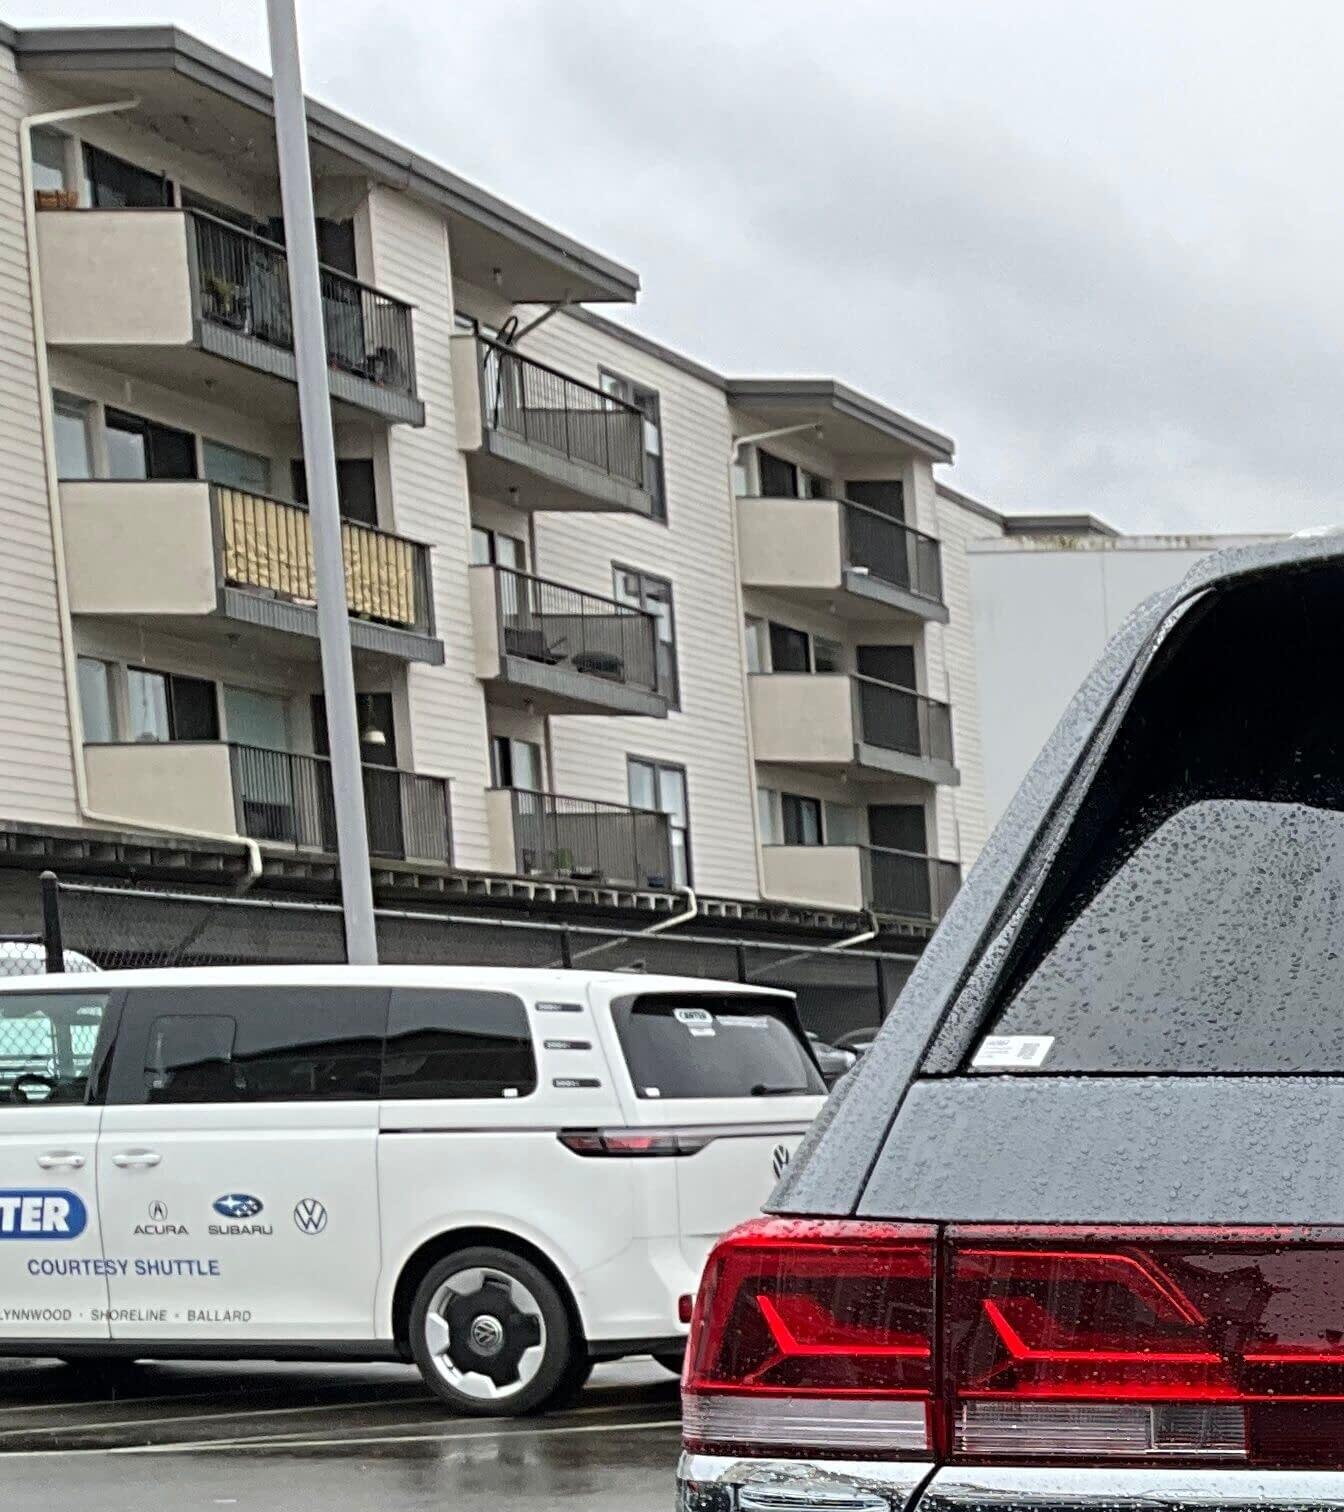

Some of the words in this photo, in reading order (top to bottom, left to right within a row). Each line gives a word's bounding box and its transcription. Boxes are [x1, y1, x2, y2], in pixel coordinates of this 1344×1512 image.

[133, 1223, 189, 1236] ACURA
[207, 1224, 274, 1236] SUBARU
[27, 1258, 129, 1277] COURTESY
[134, 1258, 221, 1277] SHUTTLE
[90, 1309, 168, 1322] SHORELINE
[187, 1309, 251, 1323] BALLARD
